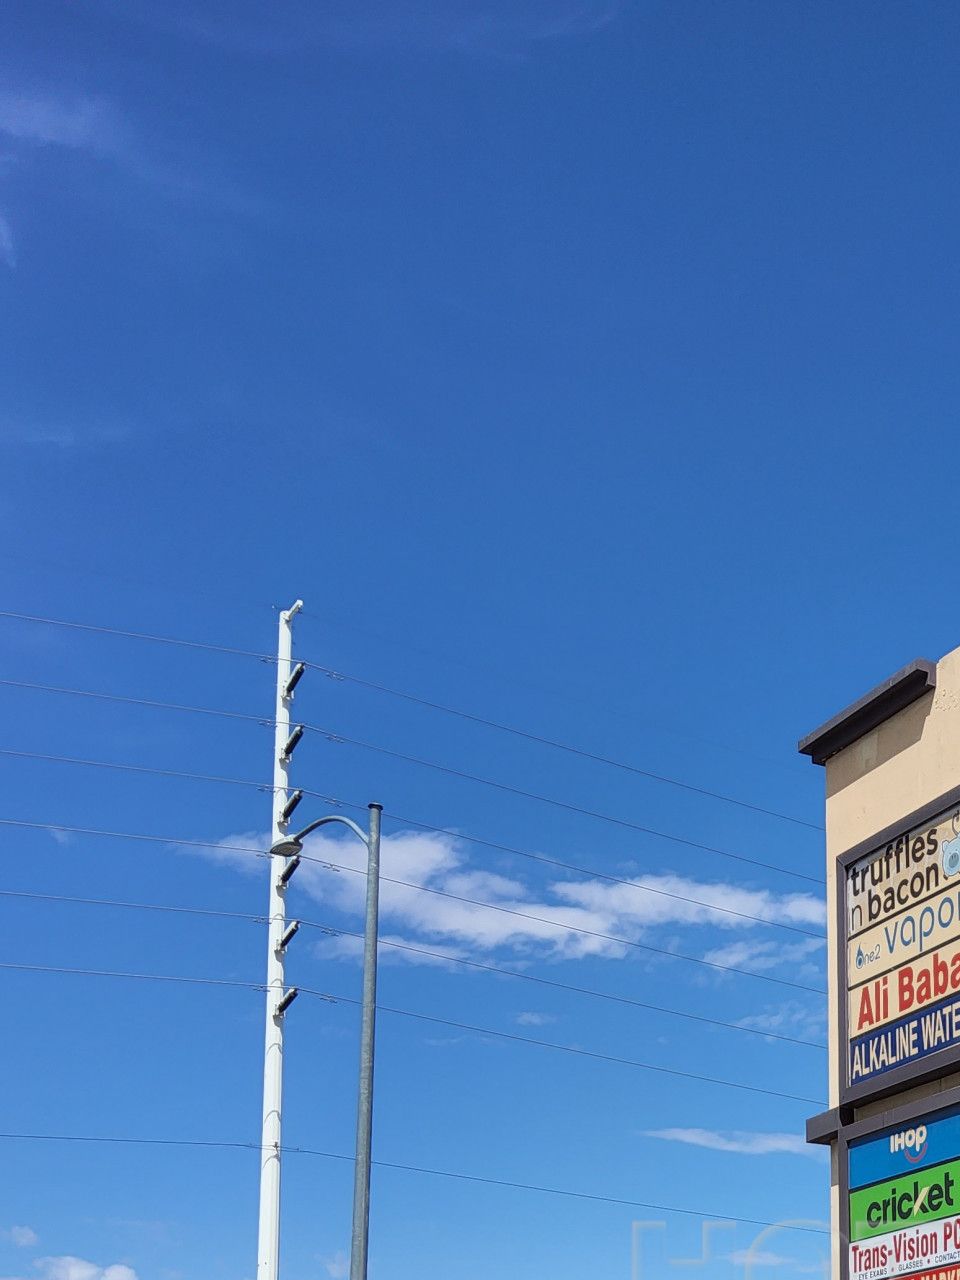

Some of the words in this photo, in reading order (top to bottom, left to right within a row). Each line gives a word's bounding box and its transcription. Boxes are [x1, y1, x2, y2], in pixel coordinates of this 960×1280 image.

[851, 828, 938, 896] truffles
[852, 904, 862, 930] n
[868, 863, 939, 921] bacon
[858, 976, 888, 1030] Ali
[853, 1020, 918, 1079] ALKALINE
[867, 1172, 954, 1228] cricket
[852, 1229, 937, 1273] Trans-Vision
[870, 1268, 888, 1279] EXAMS
[899, 1259, 924, 1271] GLASSES
